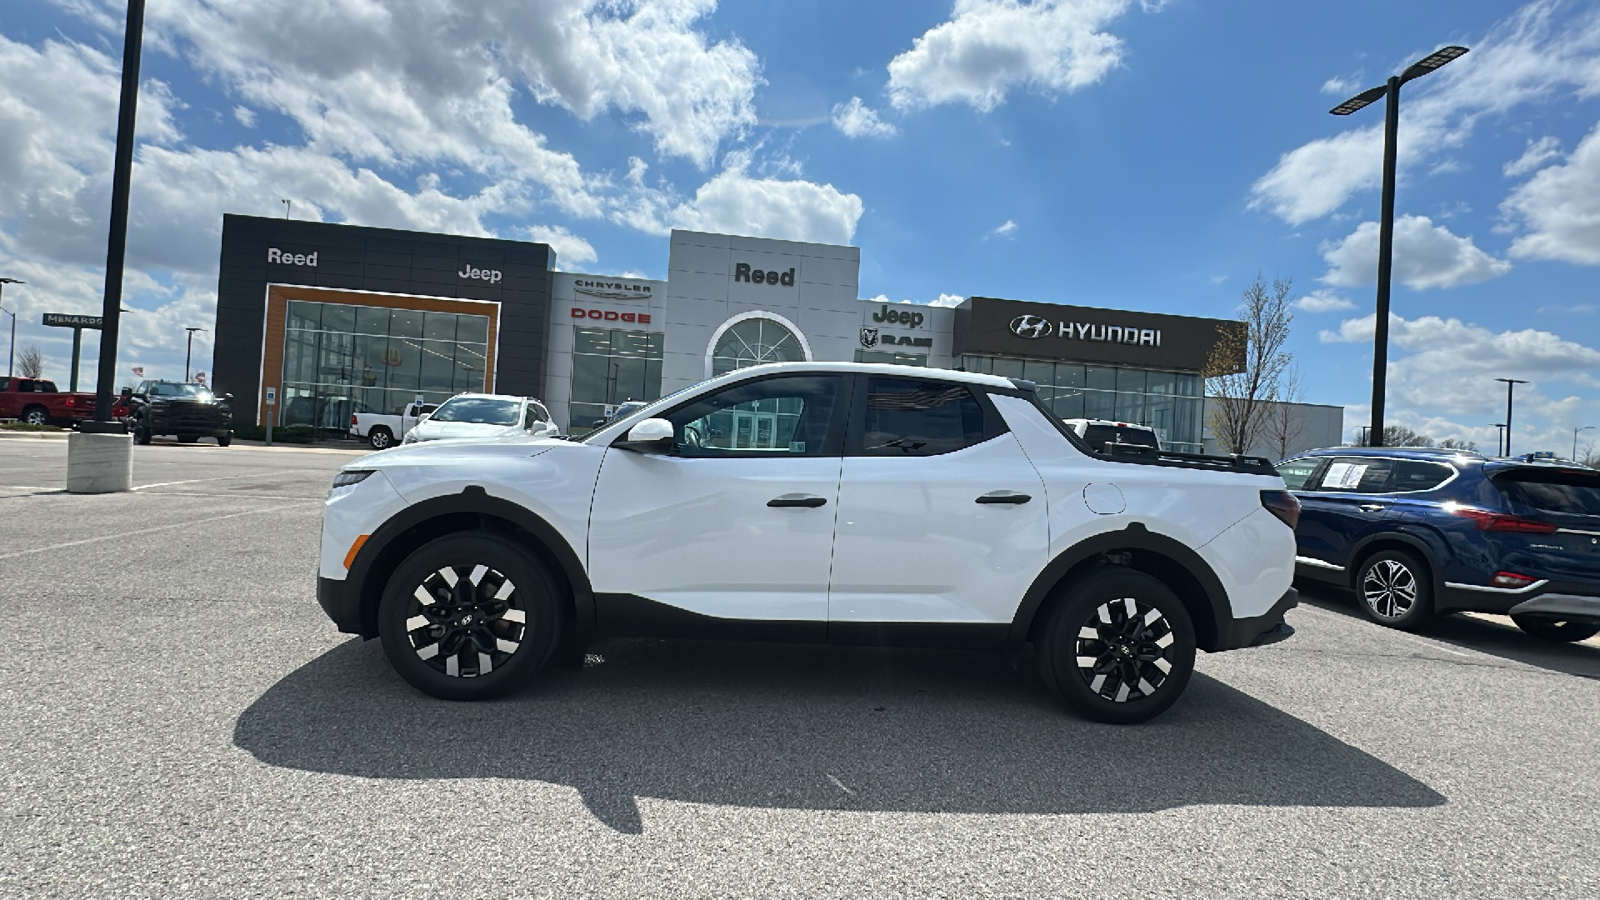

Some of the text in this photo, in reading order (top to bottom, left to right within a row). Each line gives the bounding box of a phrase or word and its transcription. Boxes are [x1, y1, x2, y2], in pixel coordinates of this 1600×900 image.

[267, 247, 318, 267] Reed
[458, 264, 503, 284] Jeep
[734, 262, 796, 287] Reed
[574, 279, 651, 293] CHRYSLER
[47, 314, 103, 325] MENARDS
[571, 307, 651, 324] DODGE
[872, 304, 924, 329] Jeep
[881, 334, 933, 348] RAM
[1058, 321, 1161, 347] HYUNDAI
